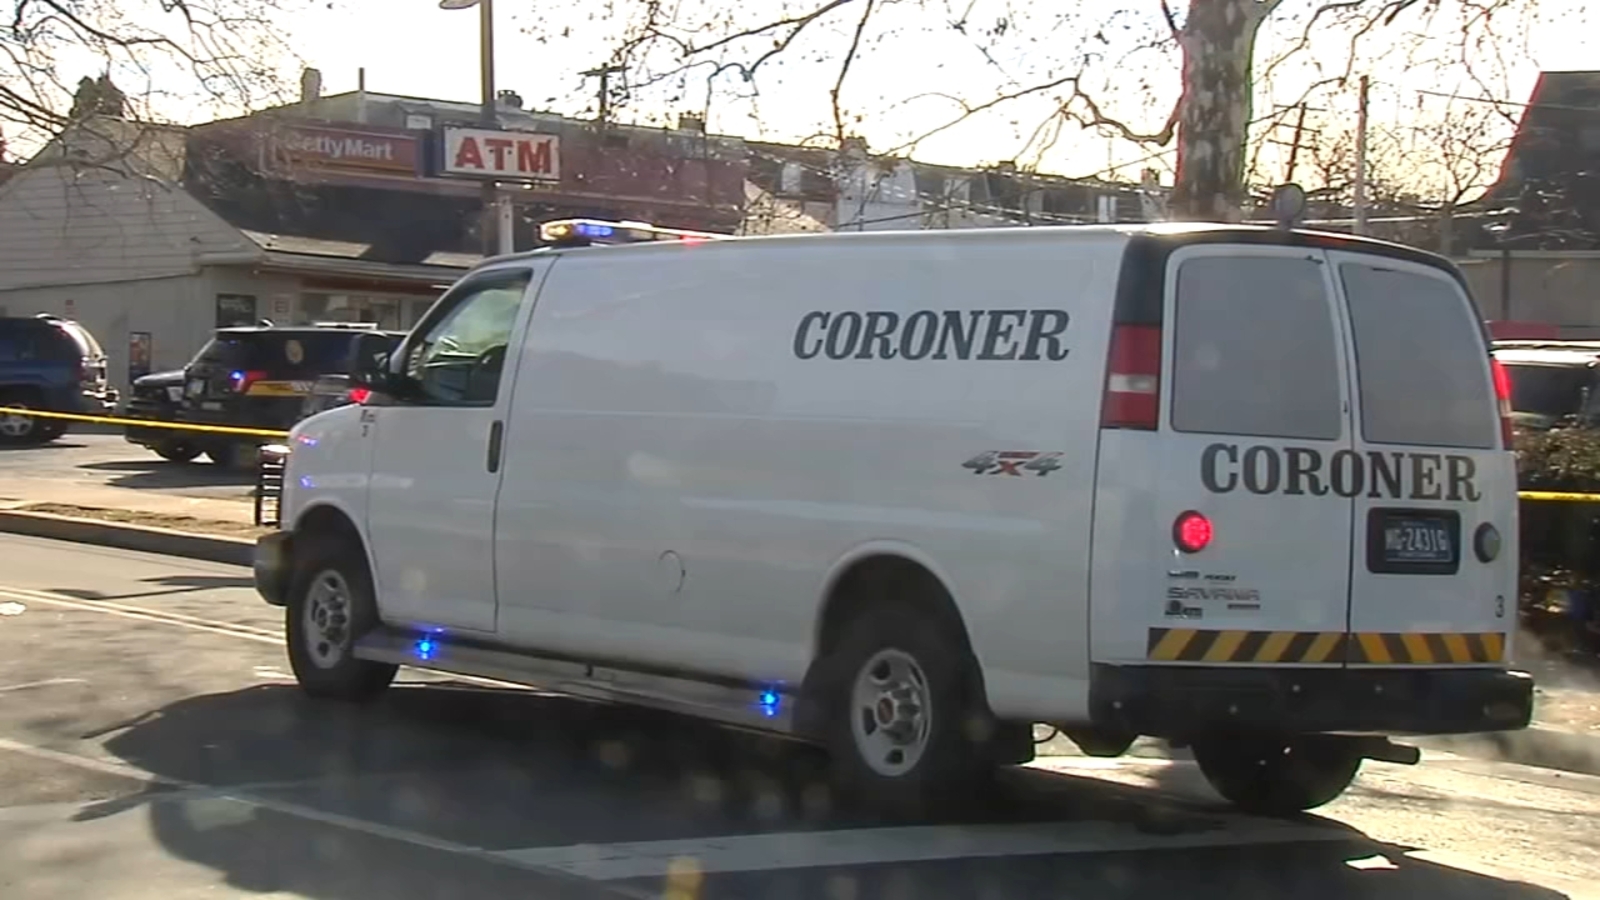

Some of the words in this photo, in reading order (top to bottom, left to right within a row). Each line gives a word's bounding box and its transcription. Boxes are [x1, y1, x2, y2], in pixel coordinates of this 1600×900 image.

[454, 136, 552, 175] ATM
[793, 310, 1070, 361] CORONER
[1200, 443, 1481, 502] CORONER
[1495, 594, 1505, 619] 3
